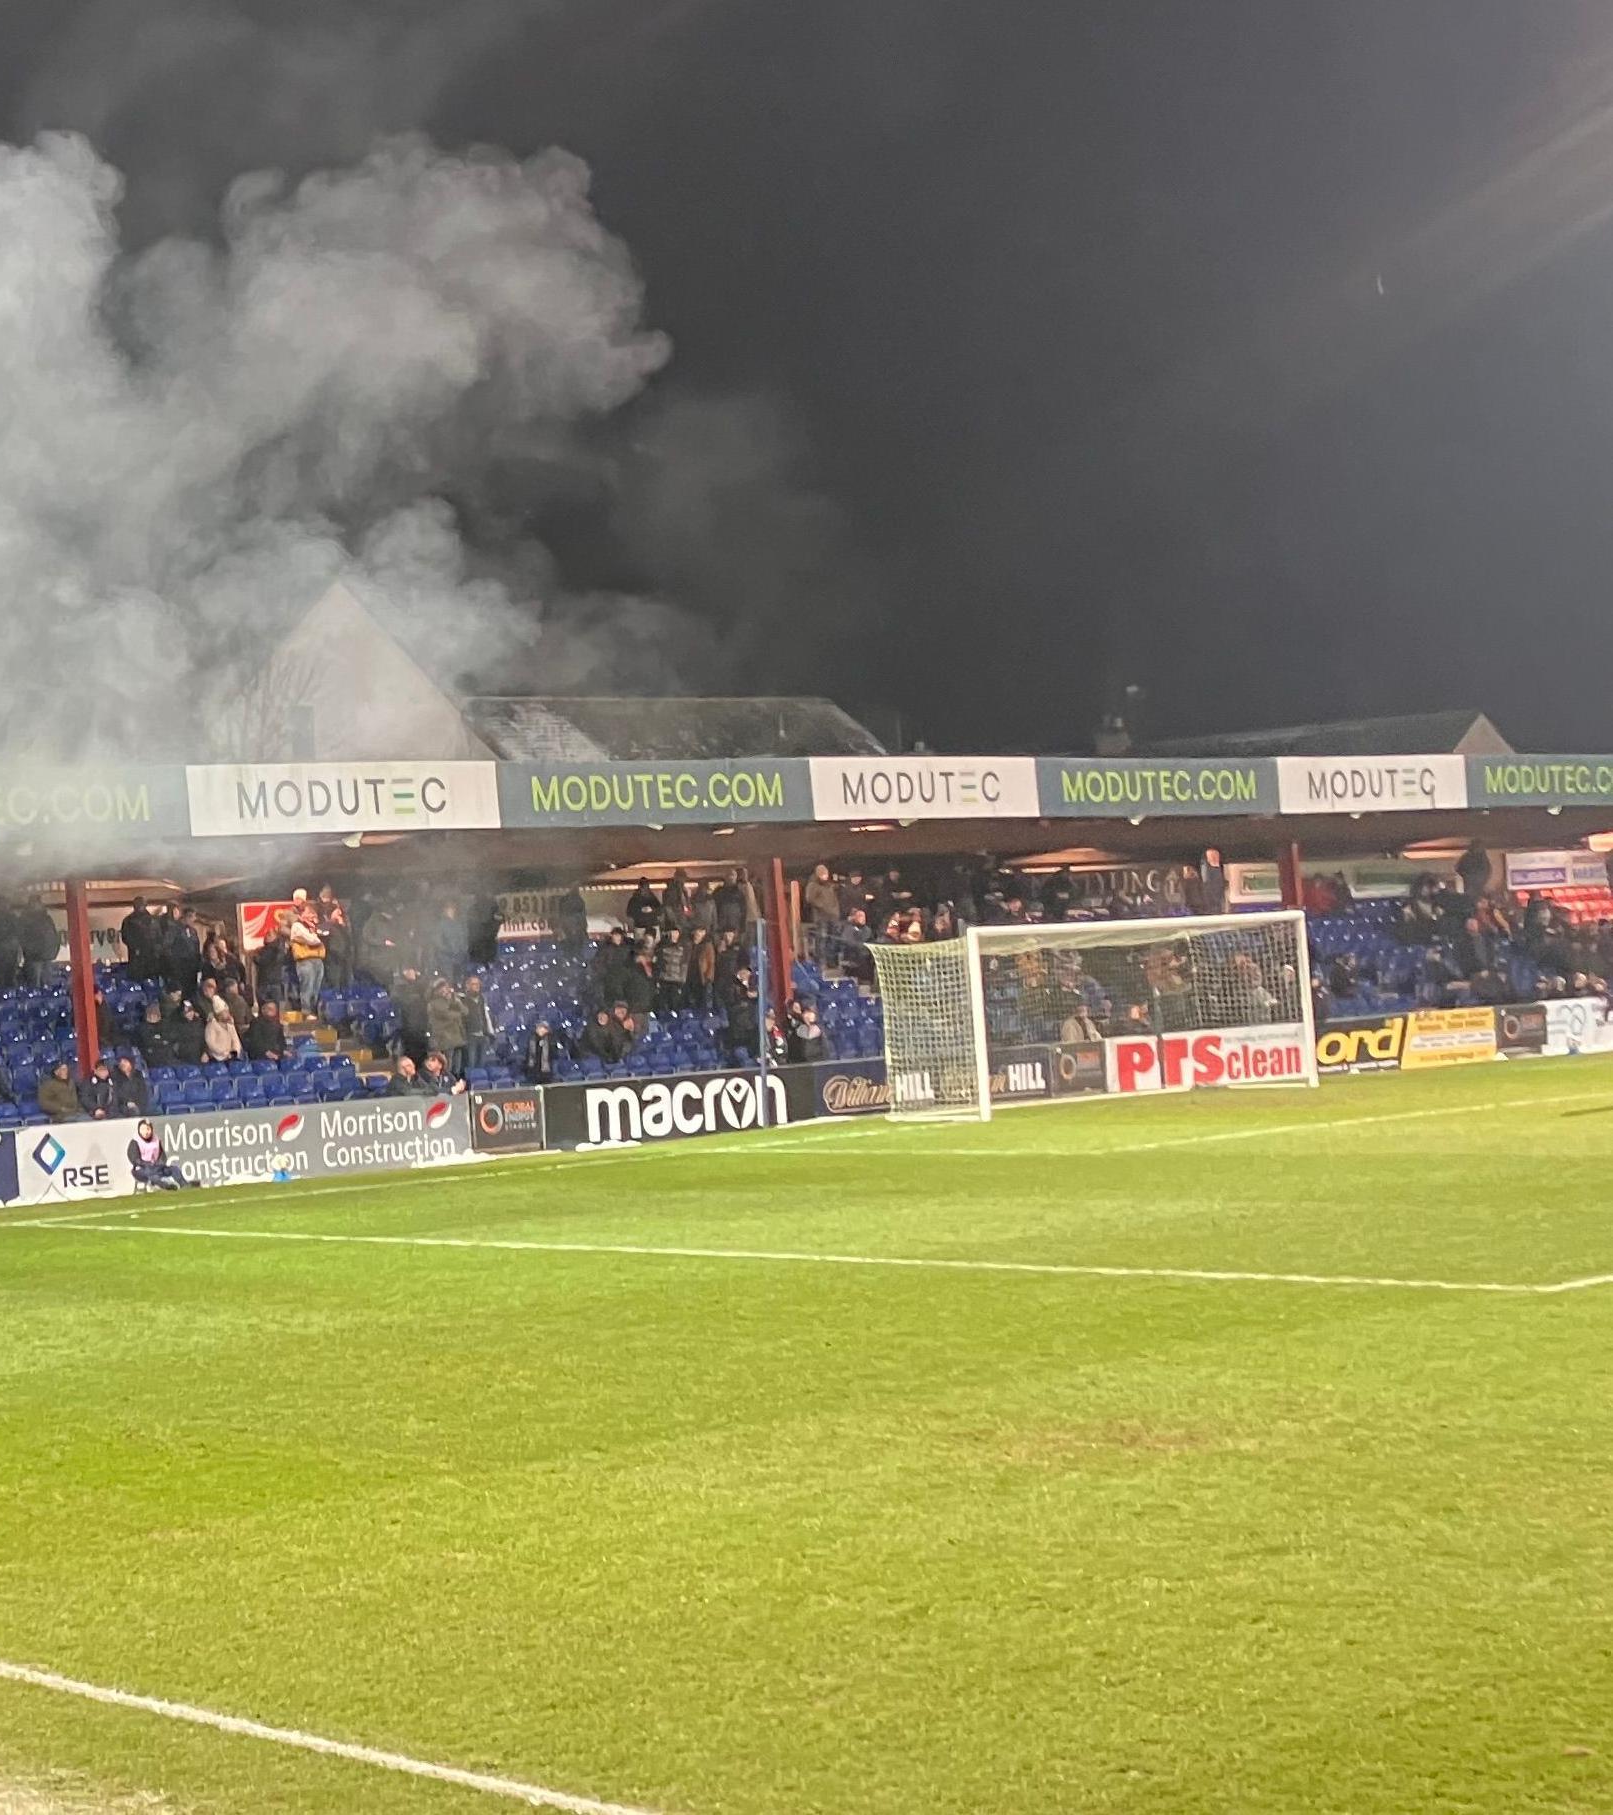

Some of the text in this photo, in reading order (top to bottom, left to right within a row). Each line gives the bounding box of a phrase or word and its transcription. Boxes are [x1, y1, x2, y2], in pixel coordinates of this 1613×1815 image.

[531, 770, 784, 812] MODUTEC.COM
[842, 770, 1001, 804] MODUTEC
[1062, 768, 1256, 804] MODUTEC.COM
[1308, 768, 1435, 799] MODUTEC
[1484, 765, 1613, 794] MODUTEC.C
[237, 777, 447, 820] MODUTEC
[895, 1072, 935, 1103] HILL
[1008, 1062, 1046, 1091] HILL
[320, 1106, 423, 1138] Morrison
[586, 1074, 788, 1142] macron
[164, 1119, 273, 1152] Morrison
[323, 1133, 456, 1169] Construction
[63, 1164, 109, 1188] RSE
